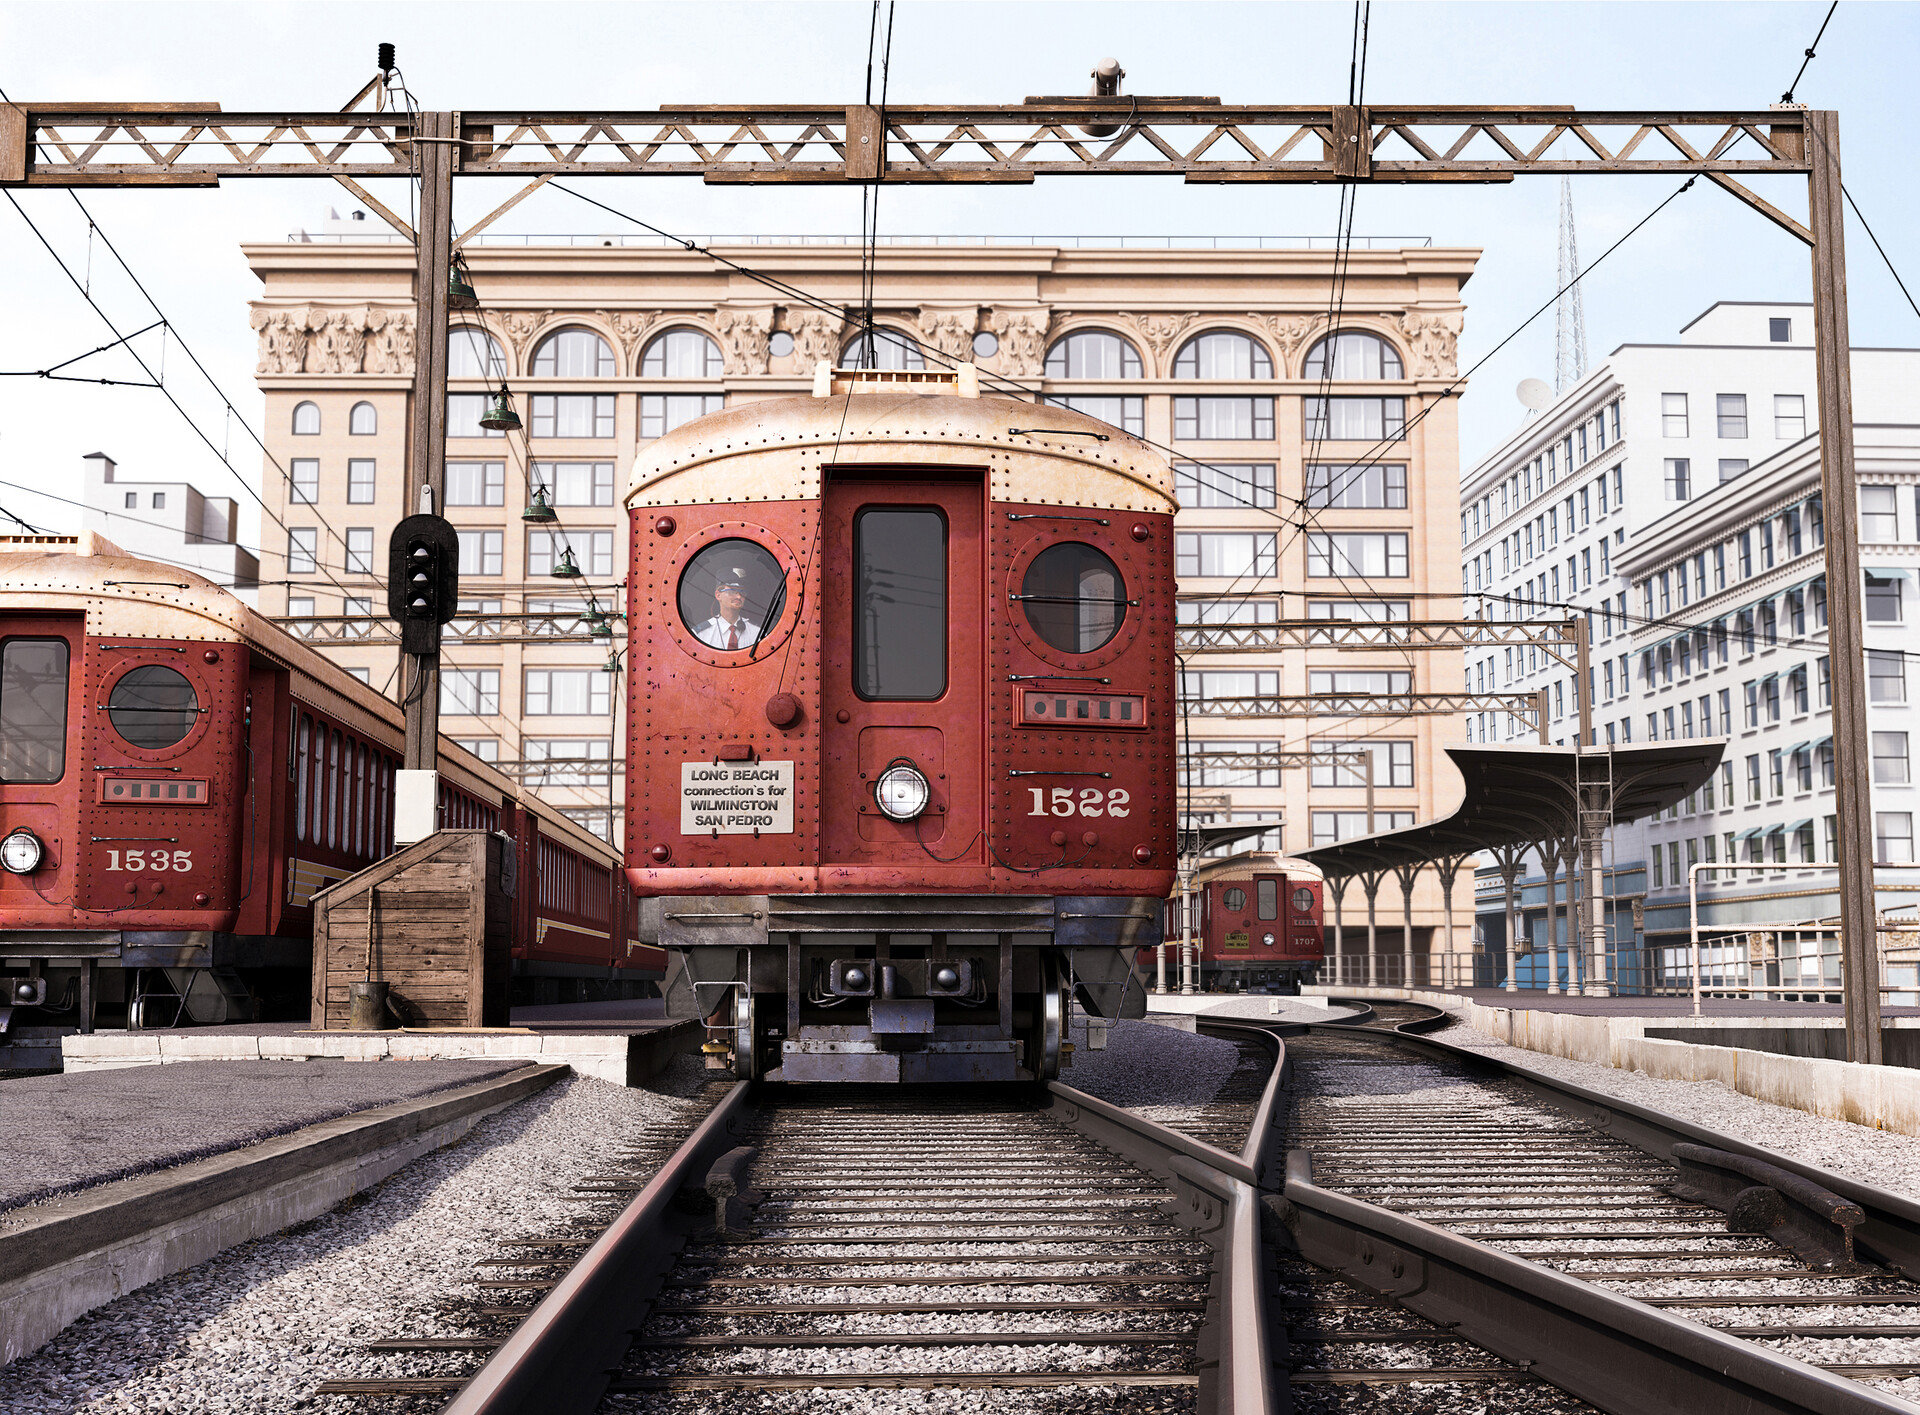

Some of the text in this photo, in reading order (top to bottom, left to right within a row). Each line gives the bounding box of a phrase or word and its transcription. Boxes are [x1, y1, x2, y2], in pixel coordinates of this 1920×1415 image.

[691, 770, 780, 781] LONG BEACH
[768, 785, 787, 796] for
[690, 800, 779, 811] WILMINGTON
[1027, 787, 1130, 818] 1522
[695, 815, 773, 826] SAN PEDRO
[105, 849, 193, 872] 1535
